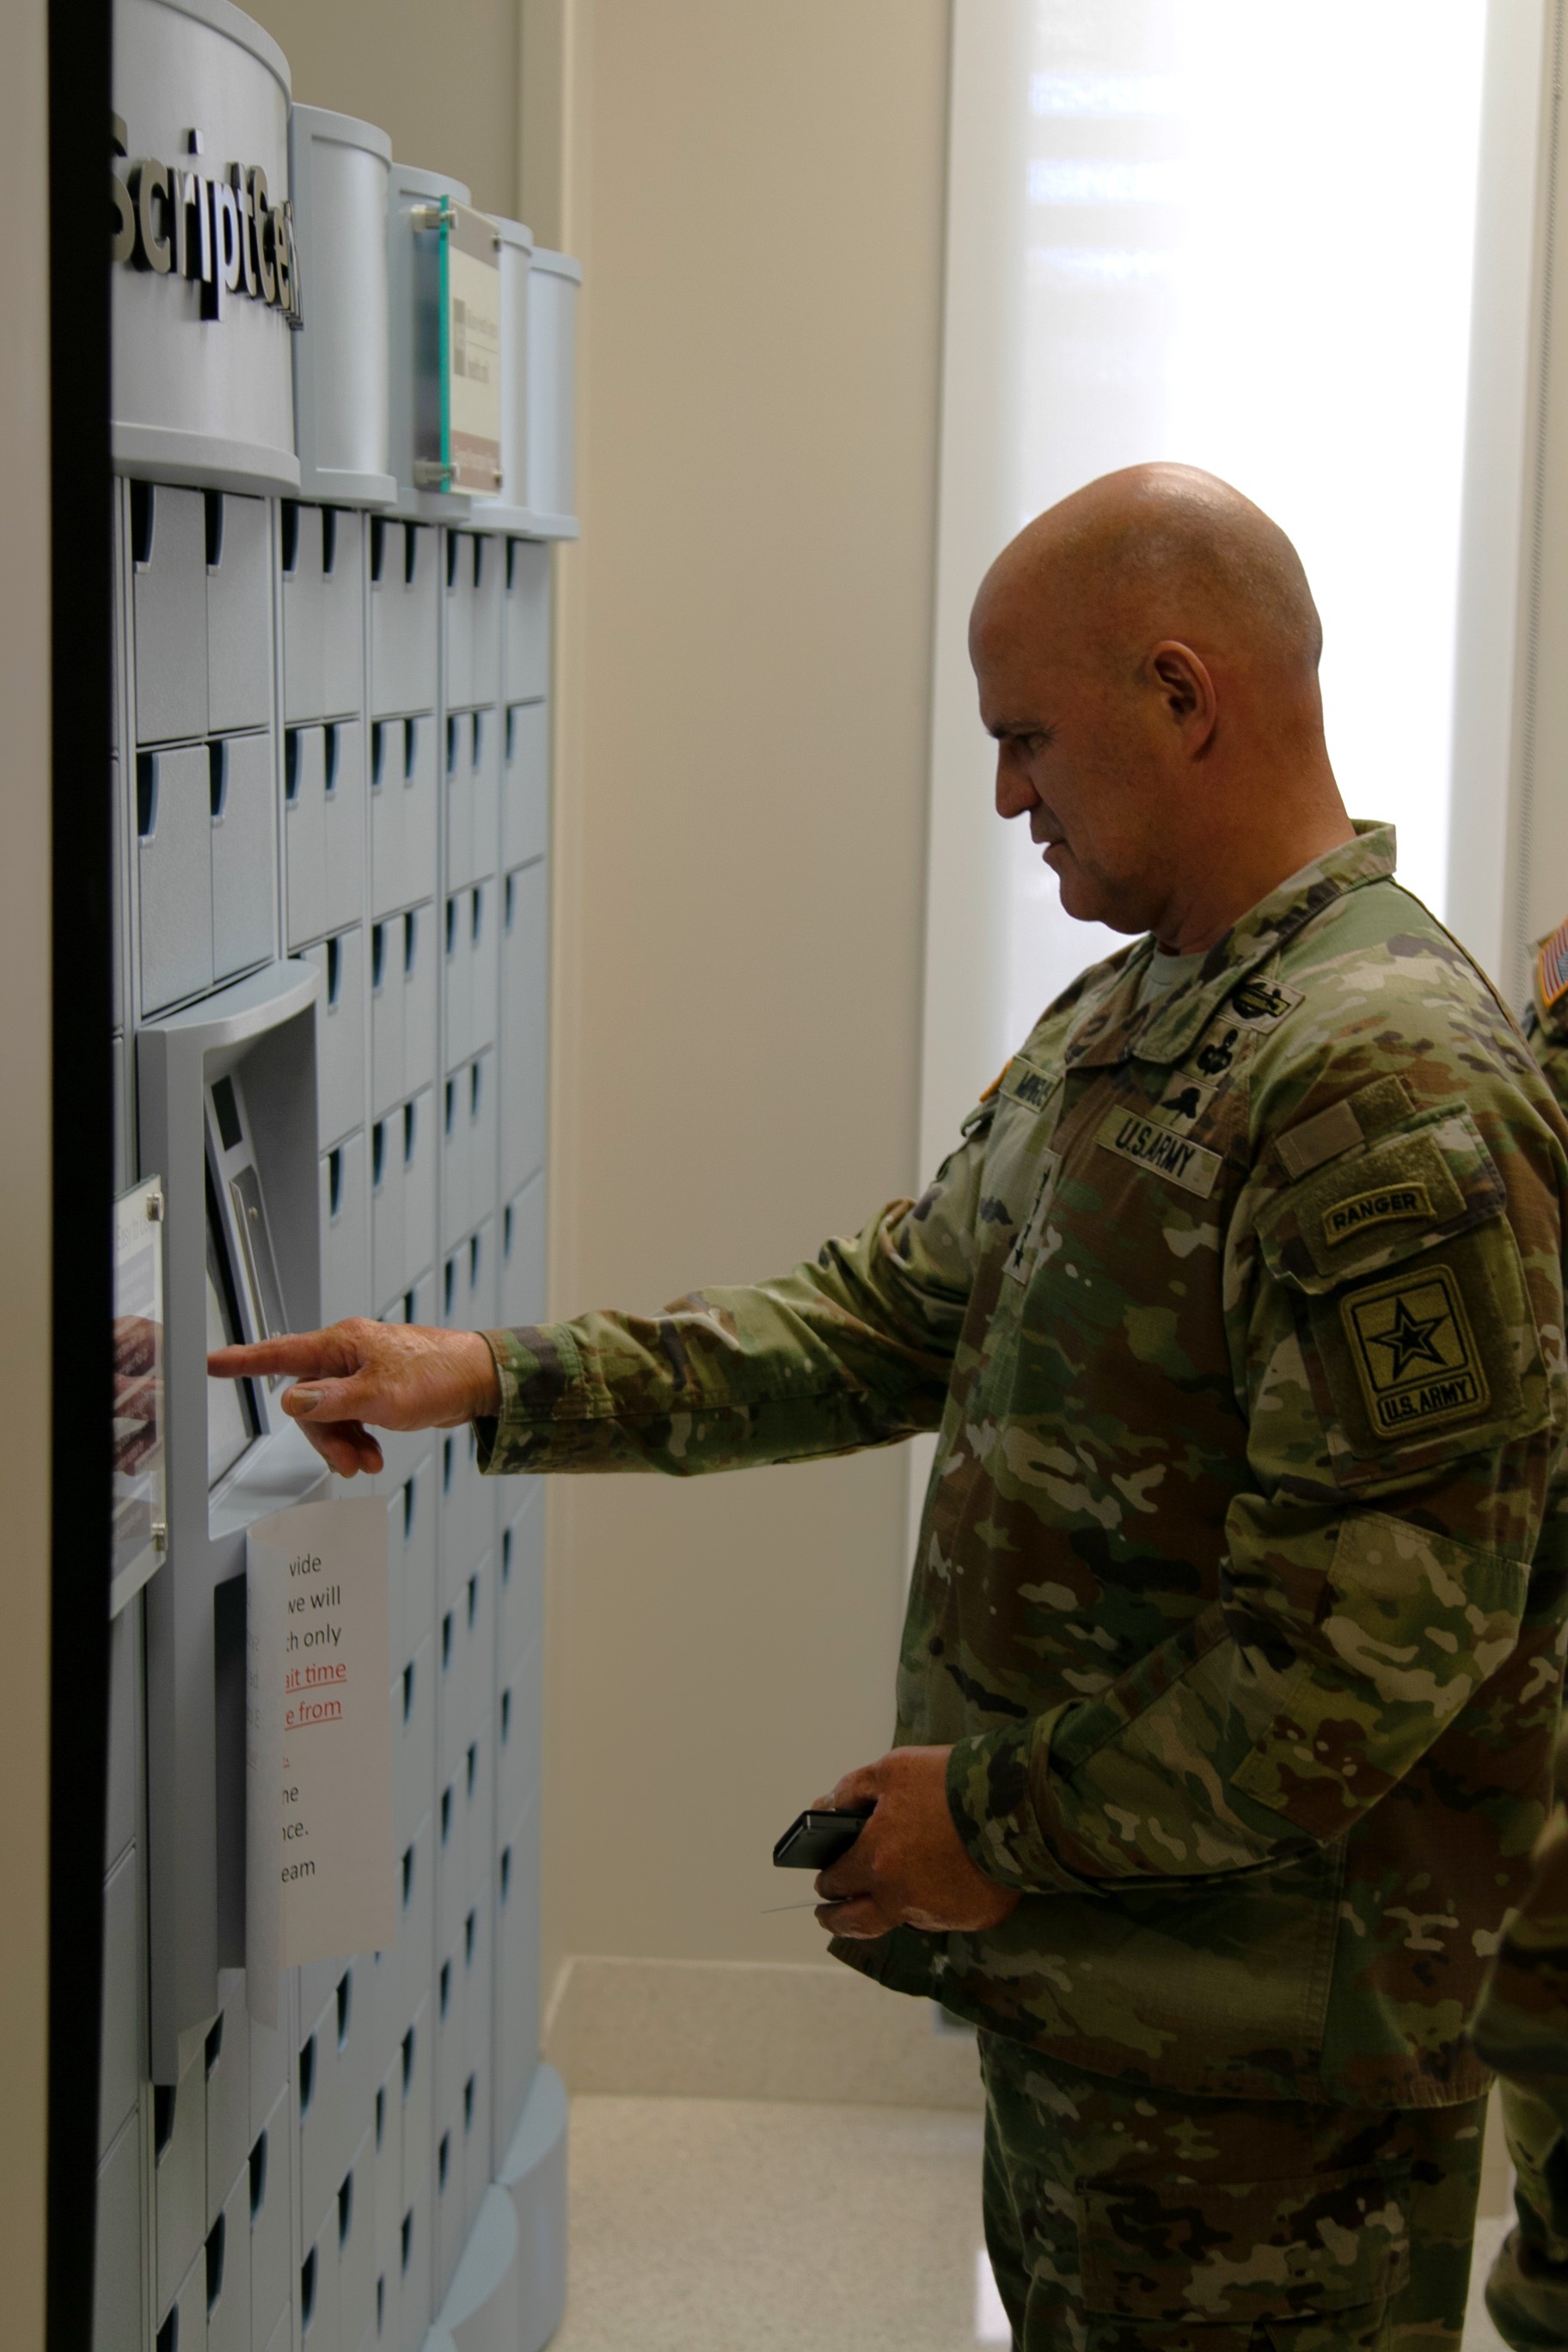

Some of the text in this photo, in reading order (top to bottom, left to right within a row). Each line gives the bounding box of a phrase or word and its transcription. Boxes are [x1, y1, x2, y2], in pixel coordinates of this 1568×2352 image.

[1332, 1192, 1417, 1231] RANGER
[1384, 1379, 1469, 1420] U.S. ARMY
[290, 1553, 322, 1577] vide
[310, 1584, 341, 1609] will
[303, 1623, 342, 1647] only
[304, 1663, 347, 1684] time
[298, 1700, 342, 1722] from
[281, 1860, 315, 1884] eam
